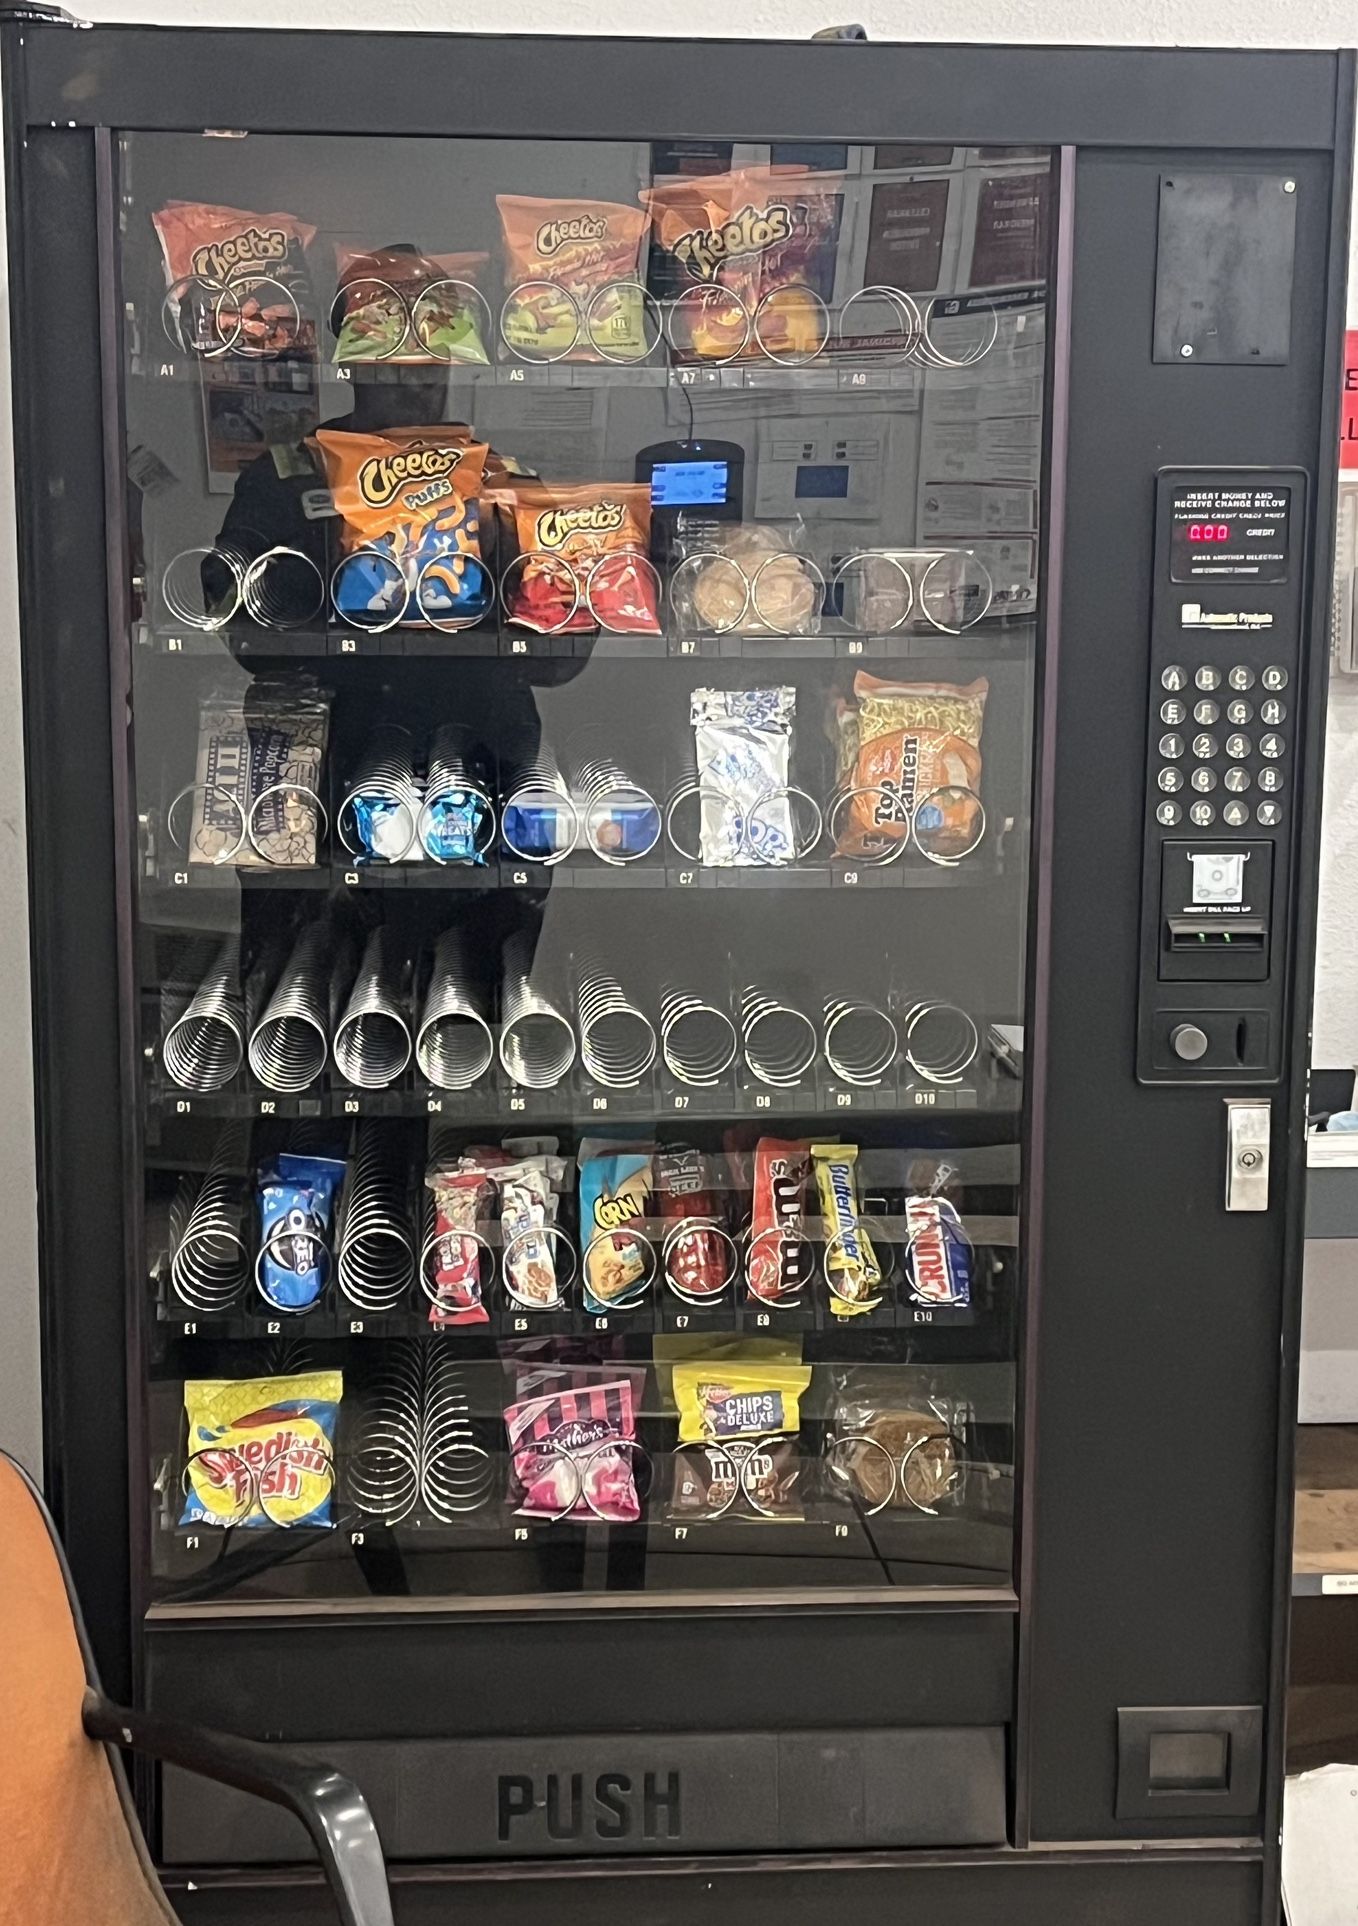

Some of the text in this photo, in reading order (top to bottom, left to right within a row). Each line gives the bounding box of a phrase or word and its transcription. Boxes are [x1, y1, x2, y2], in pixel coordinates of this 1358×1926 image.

[536, 214, 607, 257] Cheetos
[671, 203, 793, 284] Cheetos
[192, 226, 288, 284] Cheetos
[160, 364, 174, 376] A1
[336, 368, 351, 380] A3
[510, 370, 524, 381] A5
[682, 373, 695, 384] A7
[358, 448, 464, 508] Cheetos
[1255, 500, 1286, 508] BELOW
[535, 503, 627, 552] Cheetos
[169, 639, 182, 650] B1
[894, 738, 918, 824] Ramen
[873, 779, 900, 825] Top
[174, 873, 188, 884] C1
[514, 872, 527, 884] C5
[679, 873, 693, 884] C7
[844, 873, 858, 884] C9
[511, 1099, 525, 1110] D5
[593, 1098, 607, 1110] D6
[675, 1097, 689, 1108] D7
[756, 1096, 770, 1108] D8
[837, 1094, 851, 1106] D9
[915, 1093, 935, 1105] D10
[177, 1101, 191, 1112] D1
[261, 1102, 275, 1114] D2
[345, 1101, 359, 1112] D3
[427, 1101, 442, 1112] D4
[593, 1194, 641, 1230] CORN
[288, 1208, 311, 1276] OREO
[184, 1323, 197, 1334] E1
[268, 1322, 280, 1333] E2
[515, 1319, 527, 1330] E5
[725, 1395, 773, 1415] CHIPS
[727, 1411, 774, 1426] DELUXE
[199, 1431, 327, 1486] Swedish
[352, 1533, 364, 1545] F3
[515, 1528, 528, 1540] F5
[675, 1528, 688, 1540] F7
[186, 1537, 199, 1549] F1
[498, 1772, 682, 1841] PUSH
